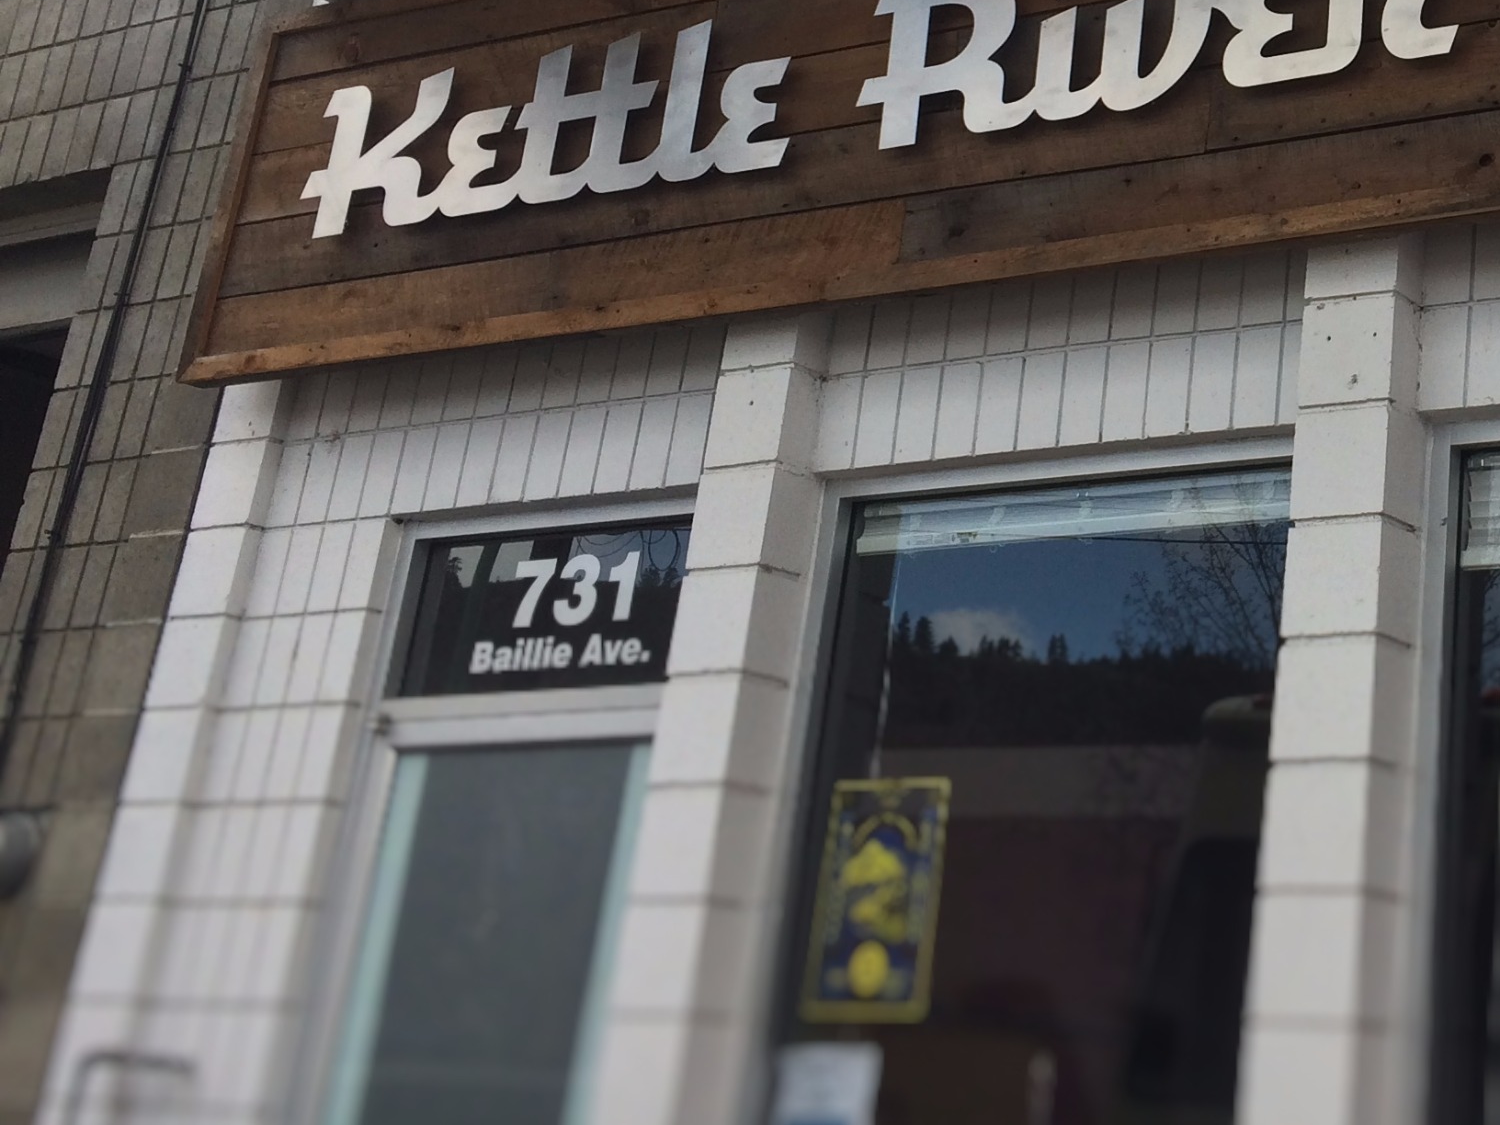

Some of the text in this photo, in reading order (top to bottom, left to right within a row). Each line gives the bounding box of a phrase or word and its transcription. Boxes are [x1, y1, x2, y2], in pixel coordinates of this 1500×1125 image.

[300, 19, 791, 239] Kettle
[511, 550, 641, 628] 731
[468, 632, 650, 675] Baillie Ave.
